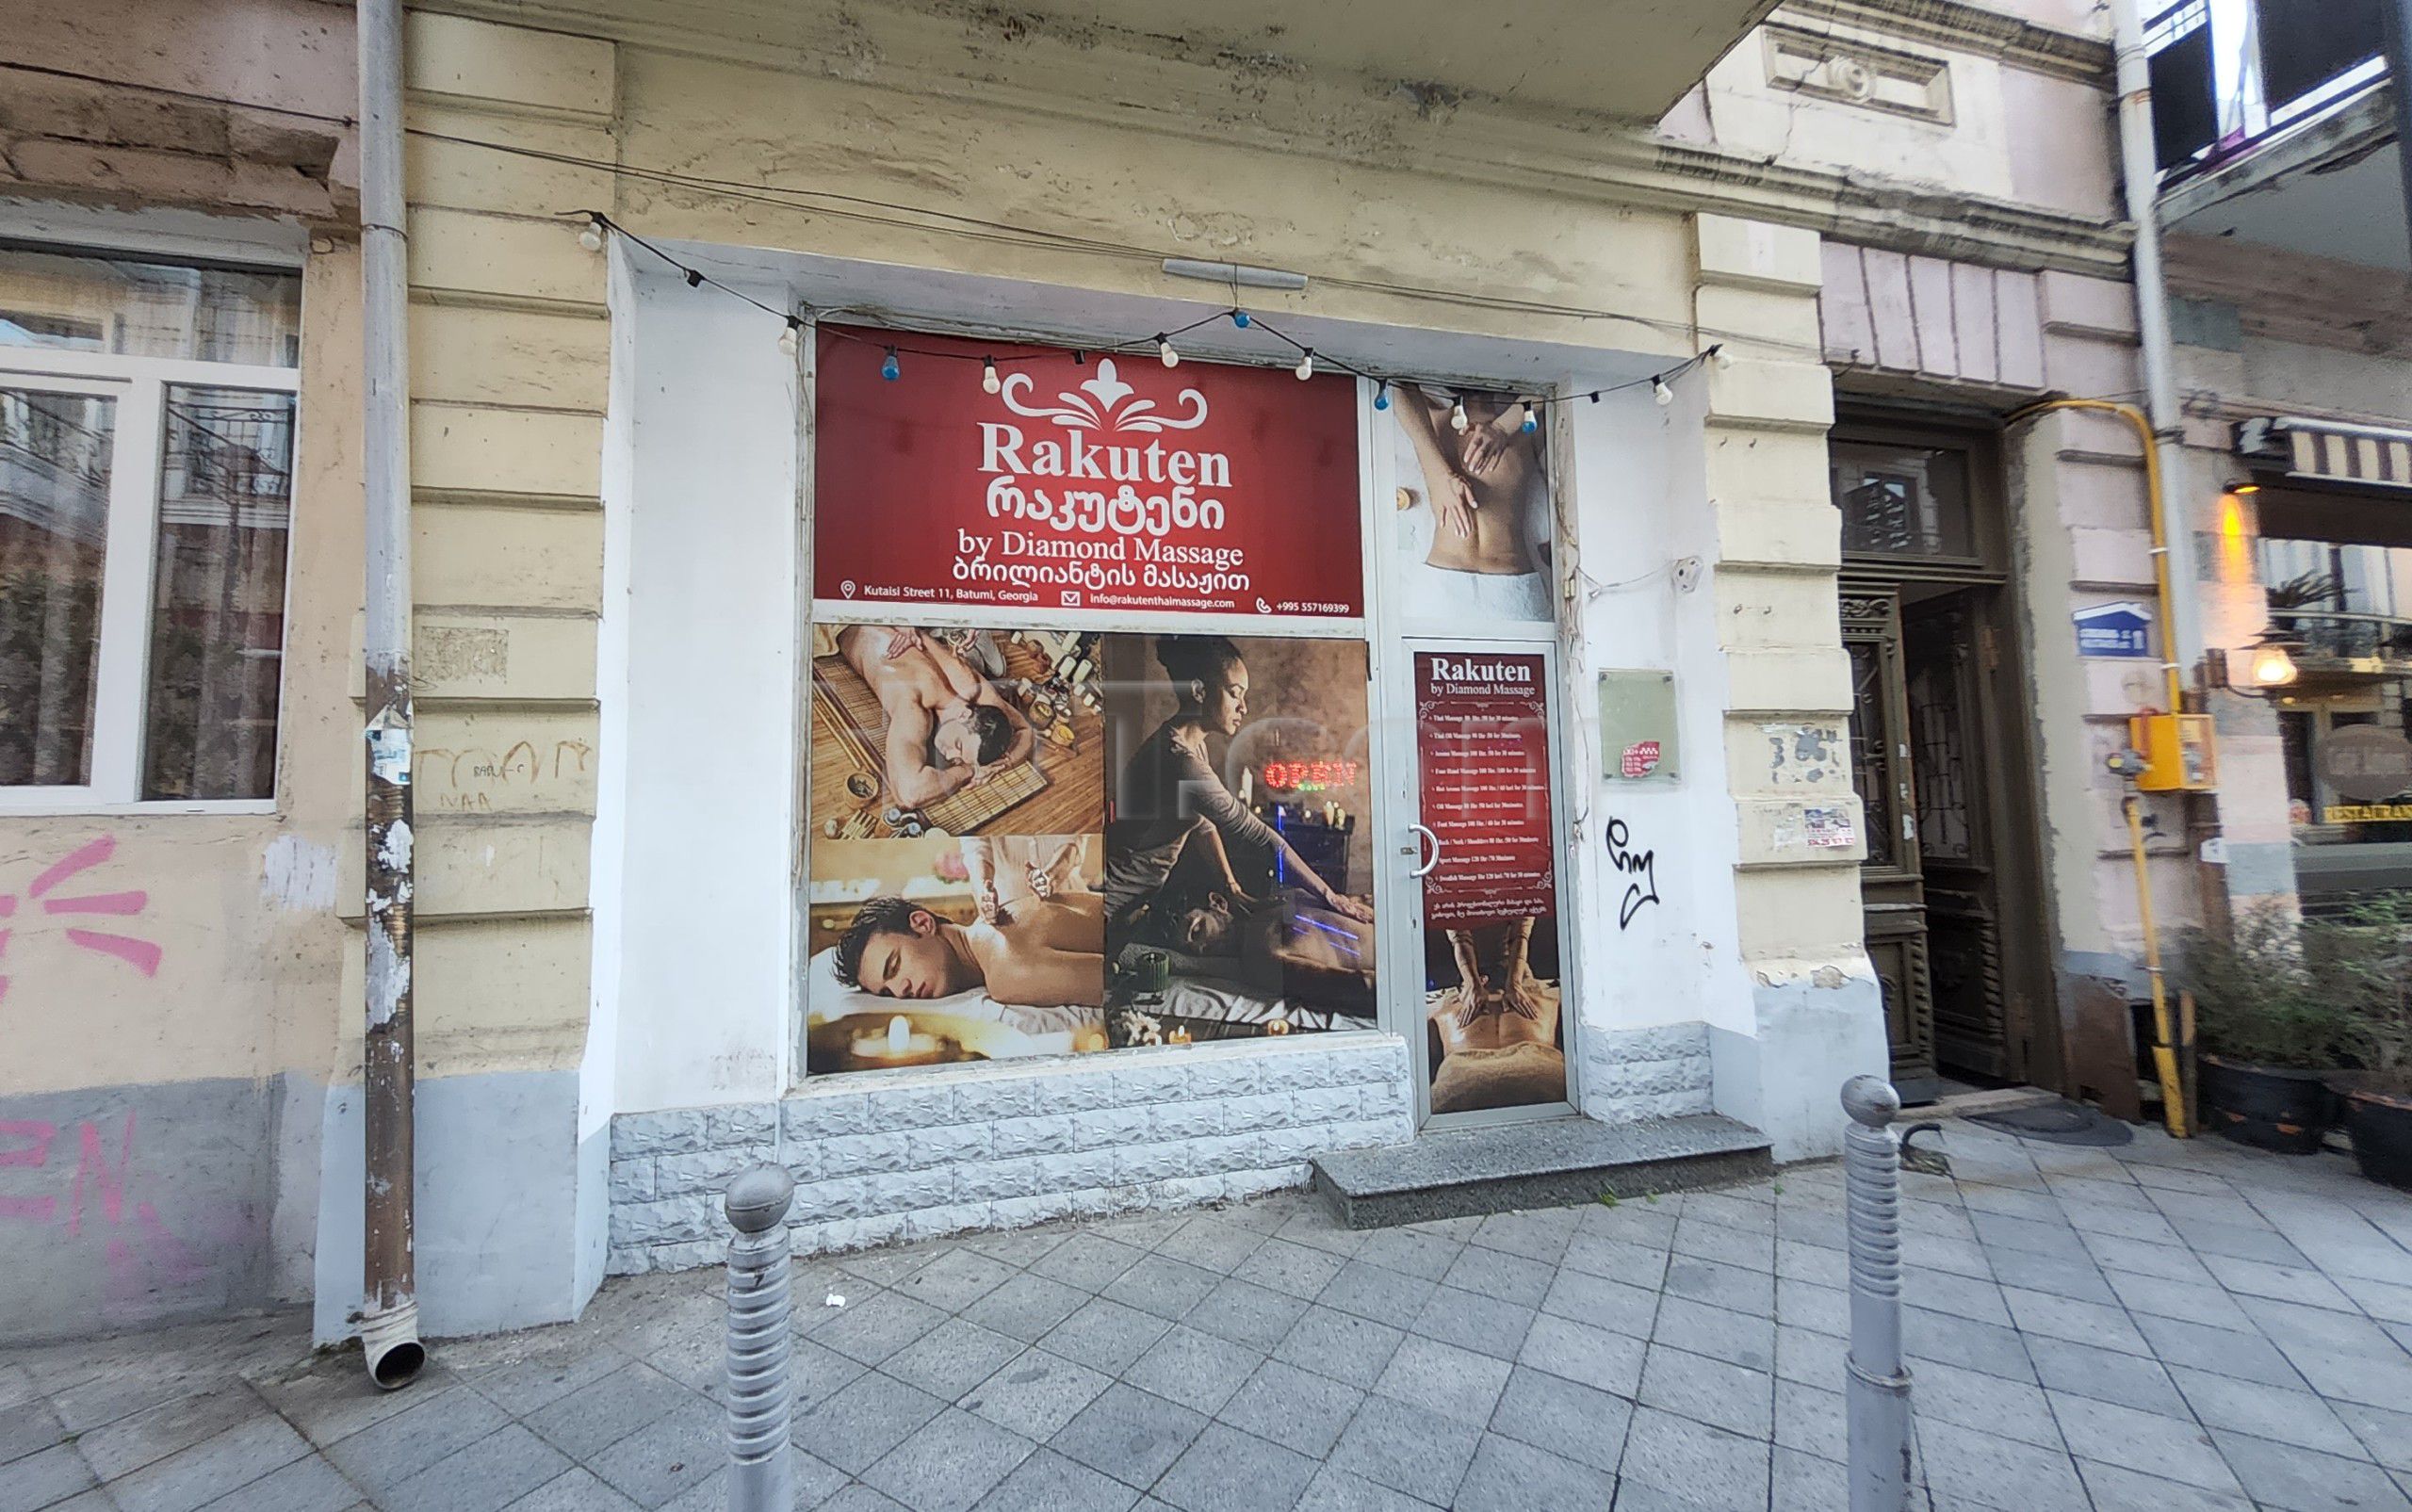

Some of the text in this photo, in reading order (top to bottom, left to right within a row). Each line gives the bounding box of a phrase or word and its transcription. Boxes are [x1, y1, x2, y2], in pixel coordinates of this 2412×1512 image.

[977, 422, 1232, 488] Rakuten
[986, 476, 1225, 536] რაკუტენი
[957, 528, 1244, 571] by Diamond Massage
[953, 556, 1249, 594] ბრილიანტის მასაჟით
[863, 584, 1039, 603] Kutaisi Street 11, Batumi, Georgia
[1276, 601, 1351, 614] +995 557169399
[1430, 658, 1532, 683] Rakuten
[1430, 683, 1537, 698] by Diamond Massage
[1265, 759, 1358, 789] OPEN
